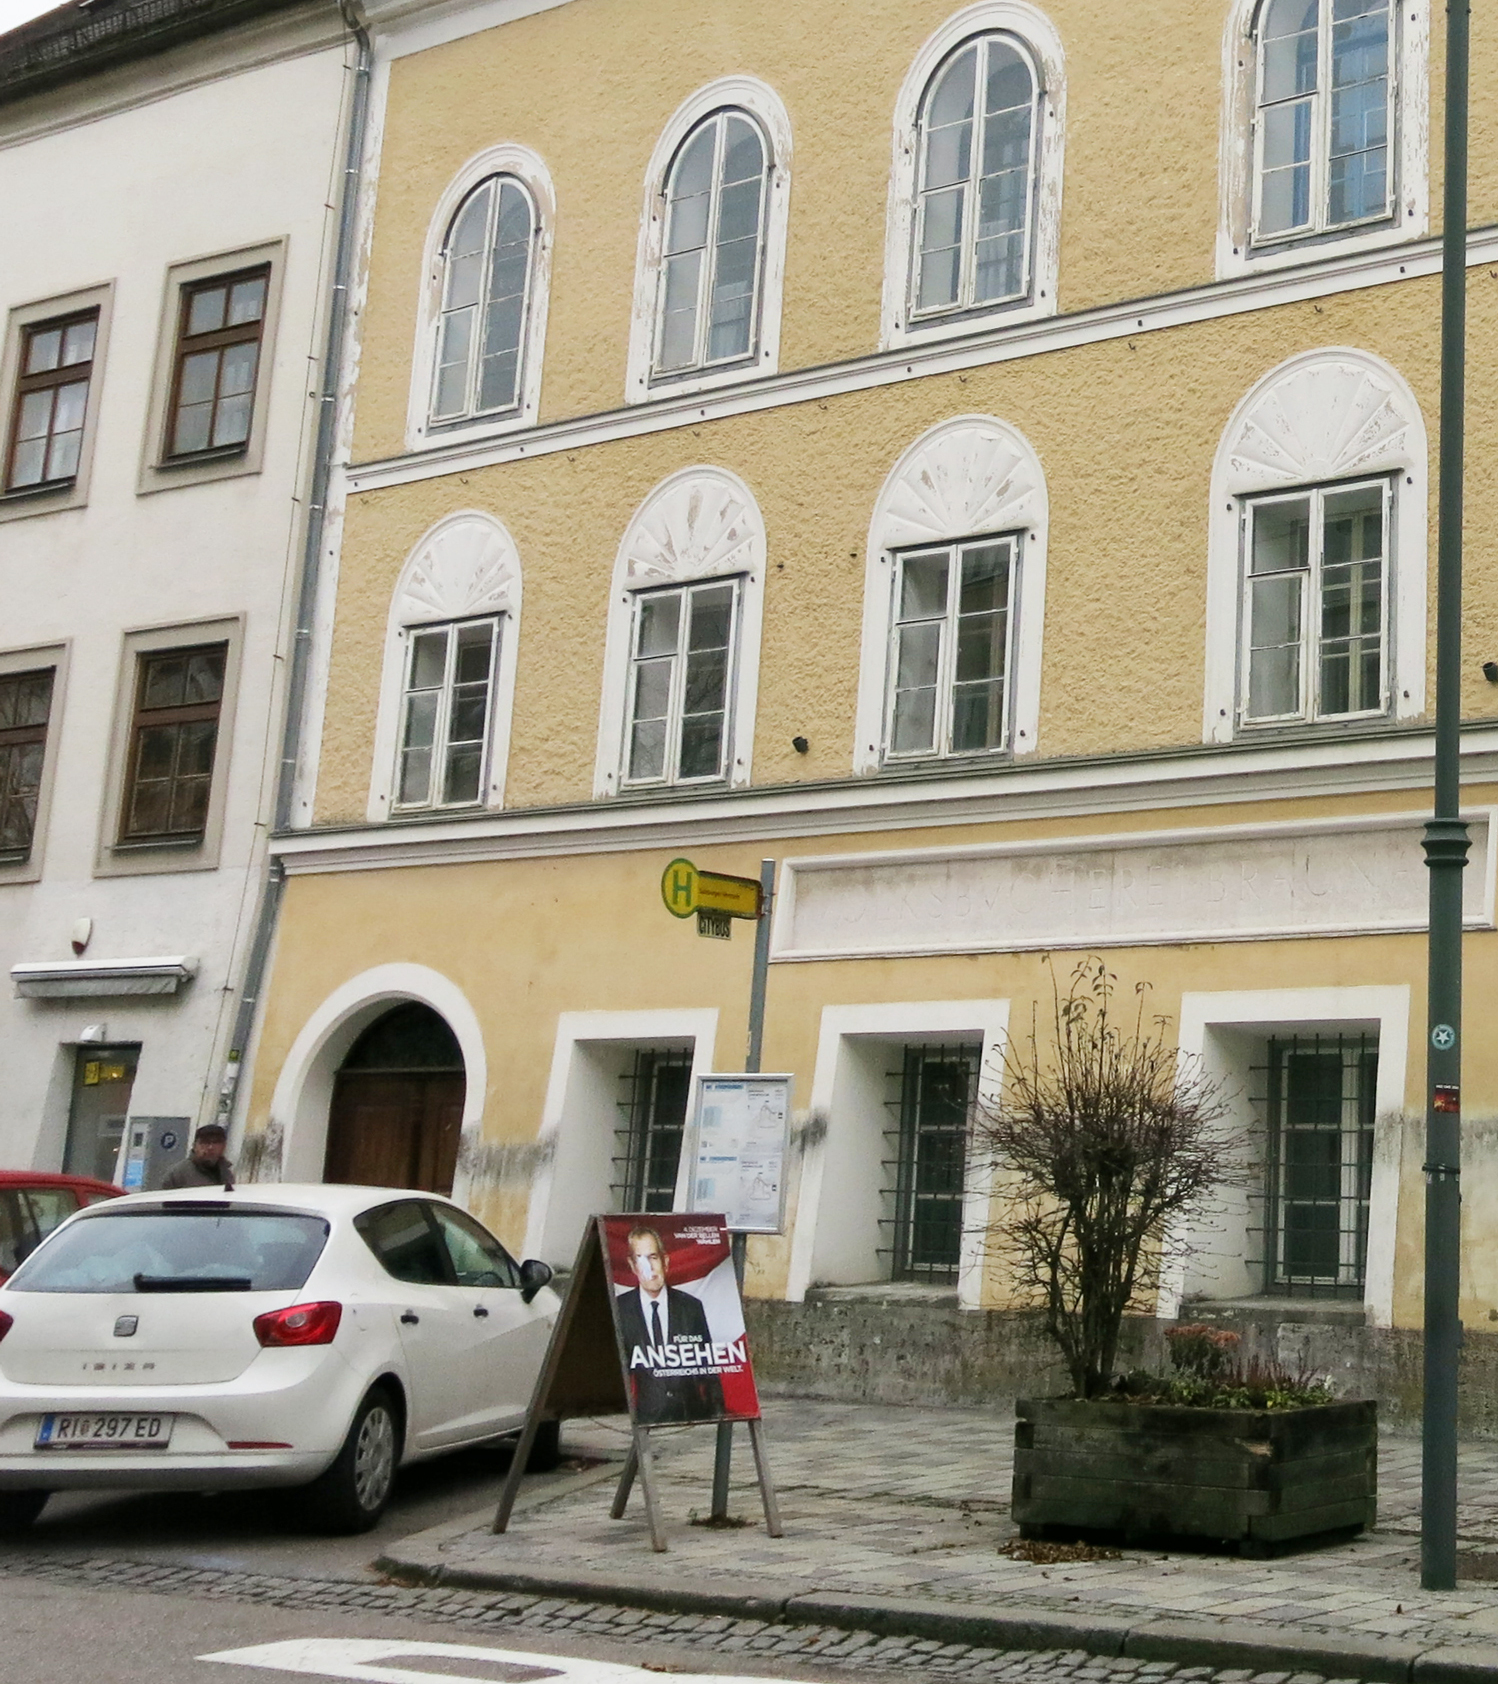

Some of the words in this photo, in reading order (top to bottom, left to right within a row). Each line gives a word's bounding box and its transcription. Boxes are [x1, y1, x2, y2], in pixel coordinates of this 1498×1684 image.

[672, 869, 693, 908] H
[673, 1334, 689, 1343] FÜR
[630, 1341, 748, 1369] ANSEHEN
[653, 1368, 699, 1377] ÖSTERREICHS
[700, 1367, 707, 1375] IN
[708, 1366, 722, 1375] DER
[92, 1417, 132, 1438] 297
[134, 1418, 161, 1438] ED
